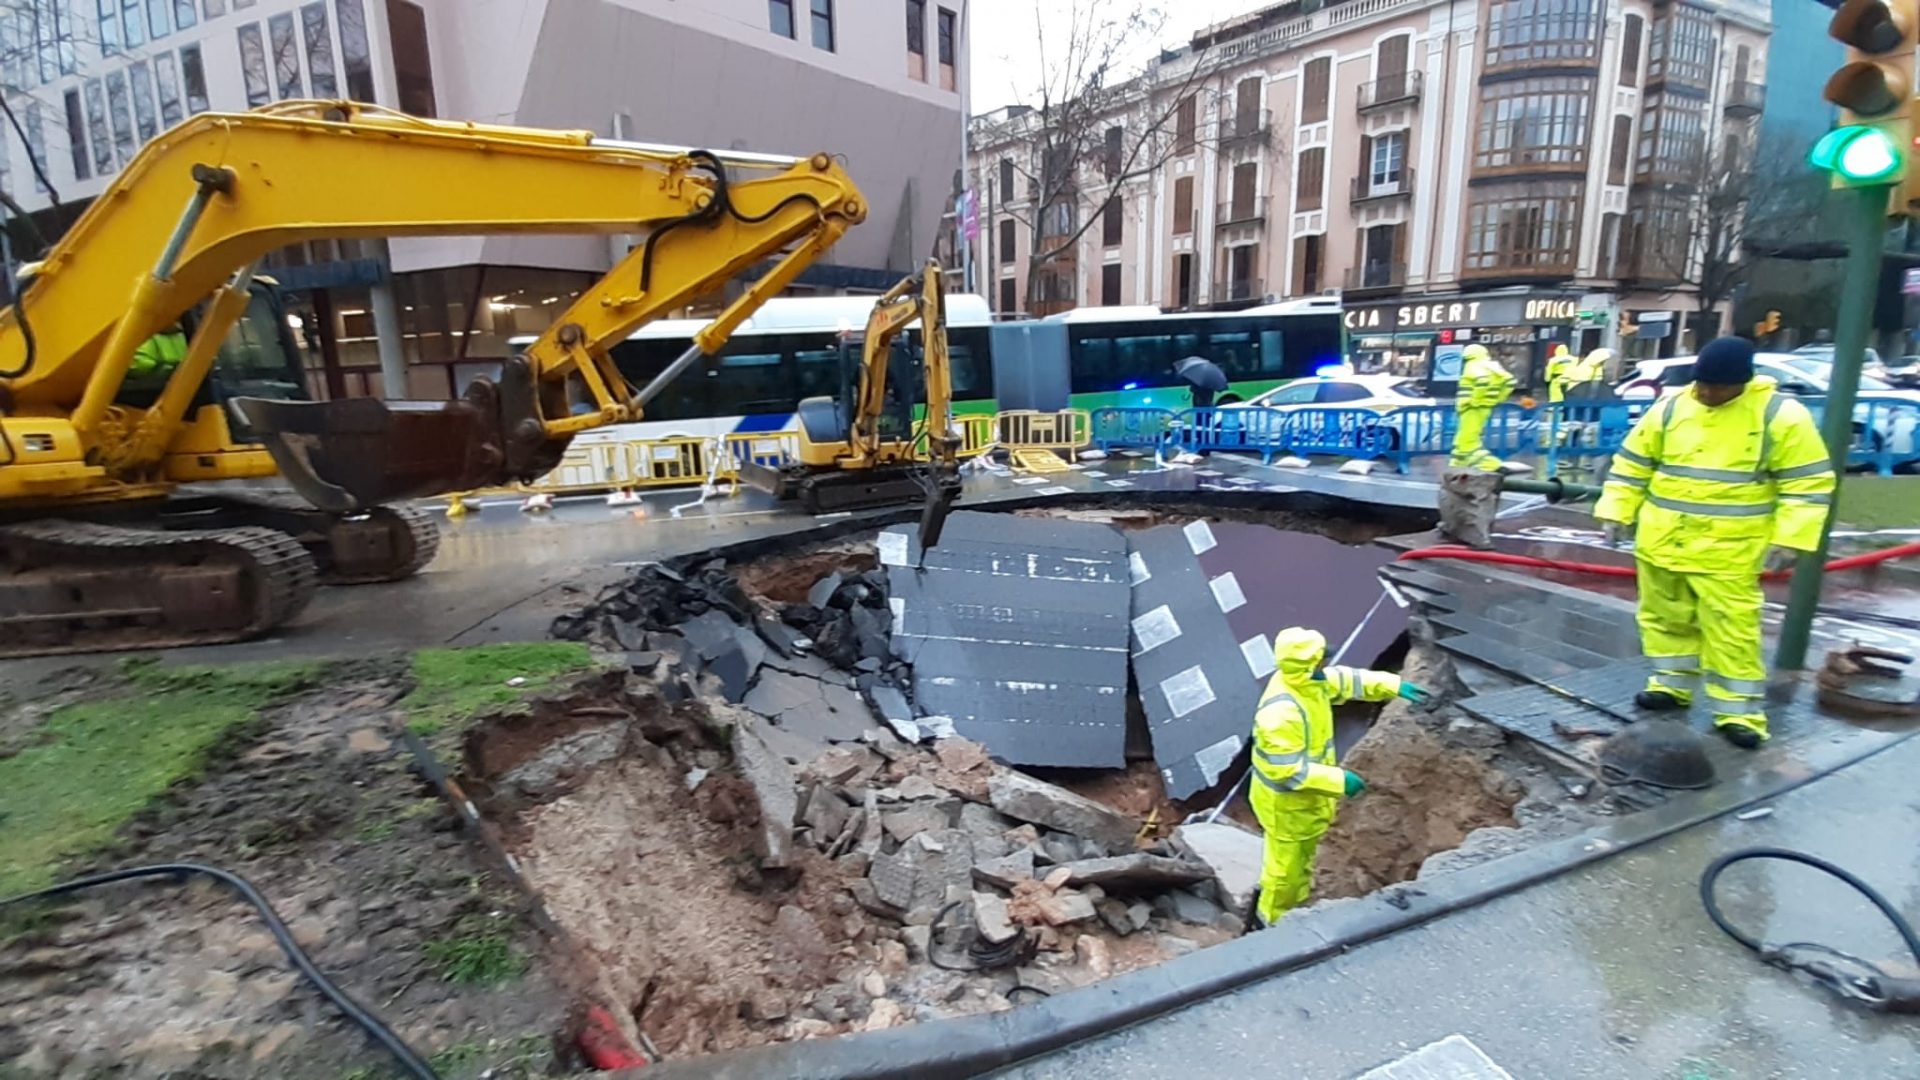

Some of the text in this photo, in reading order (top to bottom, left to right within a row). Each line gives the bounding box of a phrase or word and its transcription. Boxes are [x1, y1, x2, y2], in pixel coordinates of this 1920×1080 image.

[1398, 302, 1481, 326] SBERT
[1526, 299, 1575, 319] OPTICA
[1480, 332, 1536, 344] OPTICA
